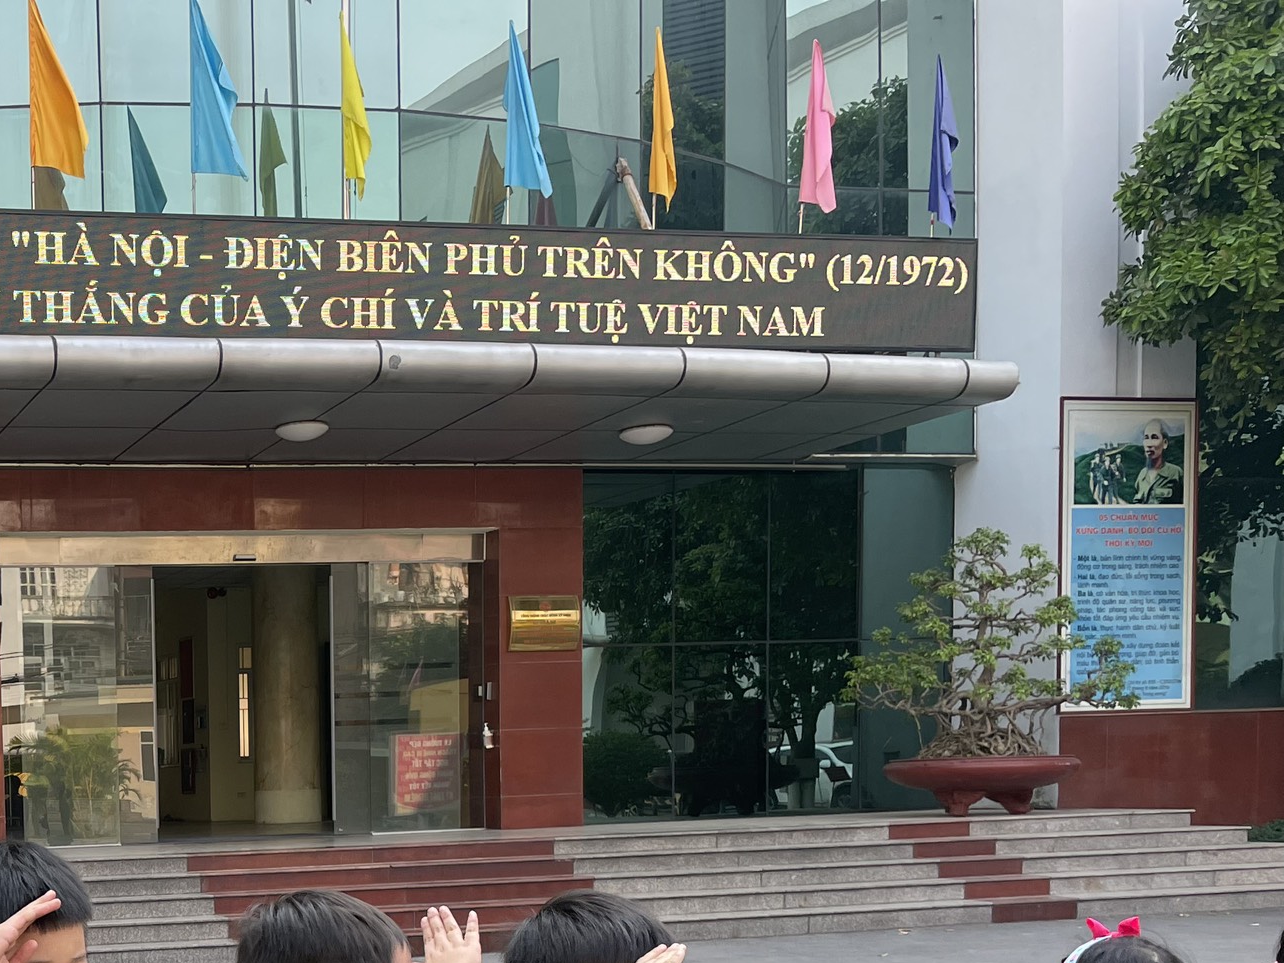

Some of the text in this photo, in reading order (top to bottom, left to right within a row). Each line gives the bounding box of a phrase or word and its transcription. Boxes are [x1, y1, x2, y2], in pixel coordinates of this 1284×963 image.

[12, 222, 99, 266] "HÀ
[109, 230, 189, 277] NỘI
[224, 234, 324, 280] ĐIỆN
[336, 230, 432, 274] BIÊN
[444, 236, 528, 277] PHỦ
[538, 237, 643, 280] TRÊN
[653, 241, 815, 283] KHÔNG"
[827, 254, 968, 294] (12/1972)
[13, 280, 169, 325] THẮNG
[181, 285, 270, 327] CỦA
[280, 286, 309, 328] Ý
[321, 288, 396, 330] CHÍ
[405, 290, 463, 331] VÀ
[473, 291, 541, 332] TRÍ
[550, 299, 627, 343] TUỆ
[638, 301, 727, 344] VIỆT
[737, 306, 825, 336] NAM
